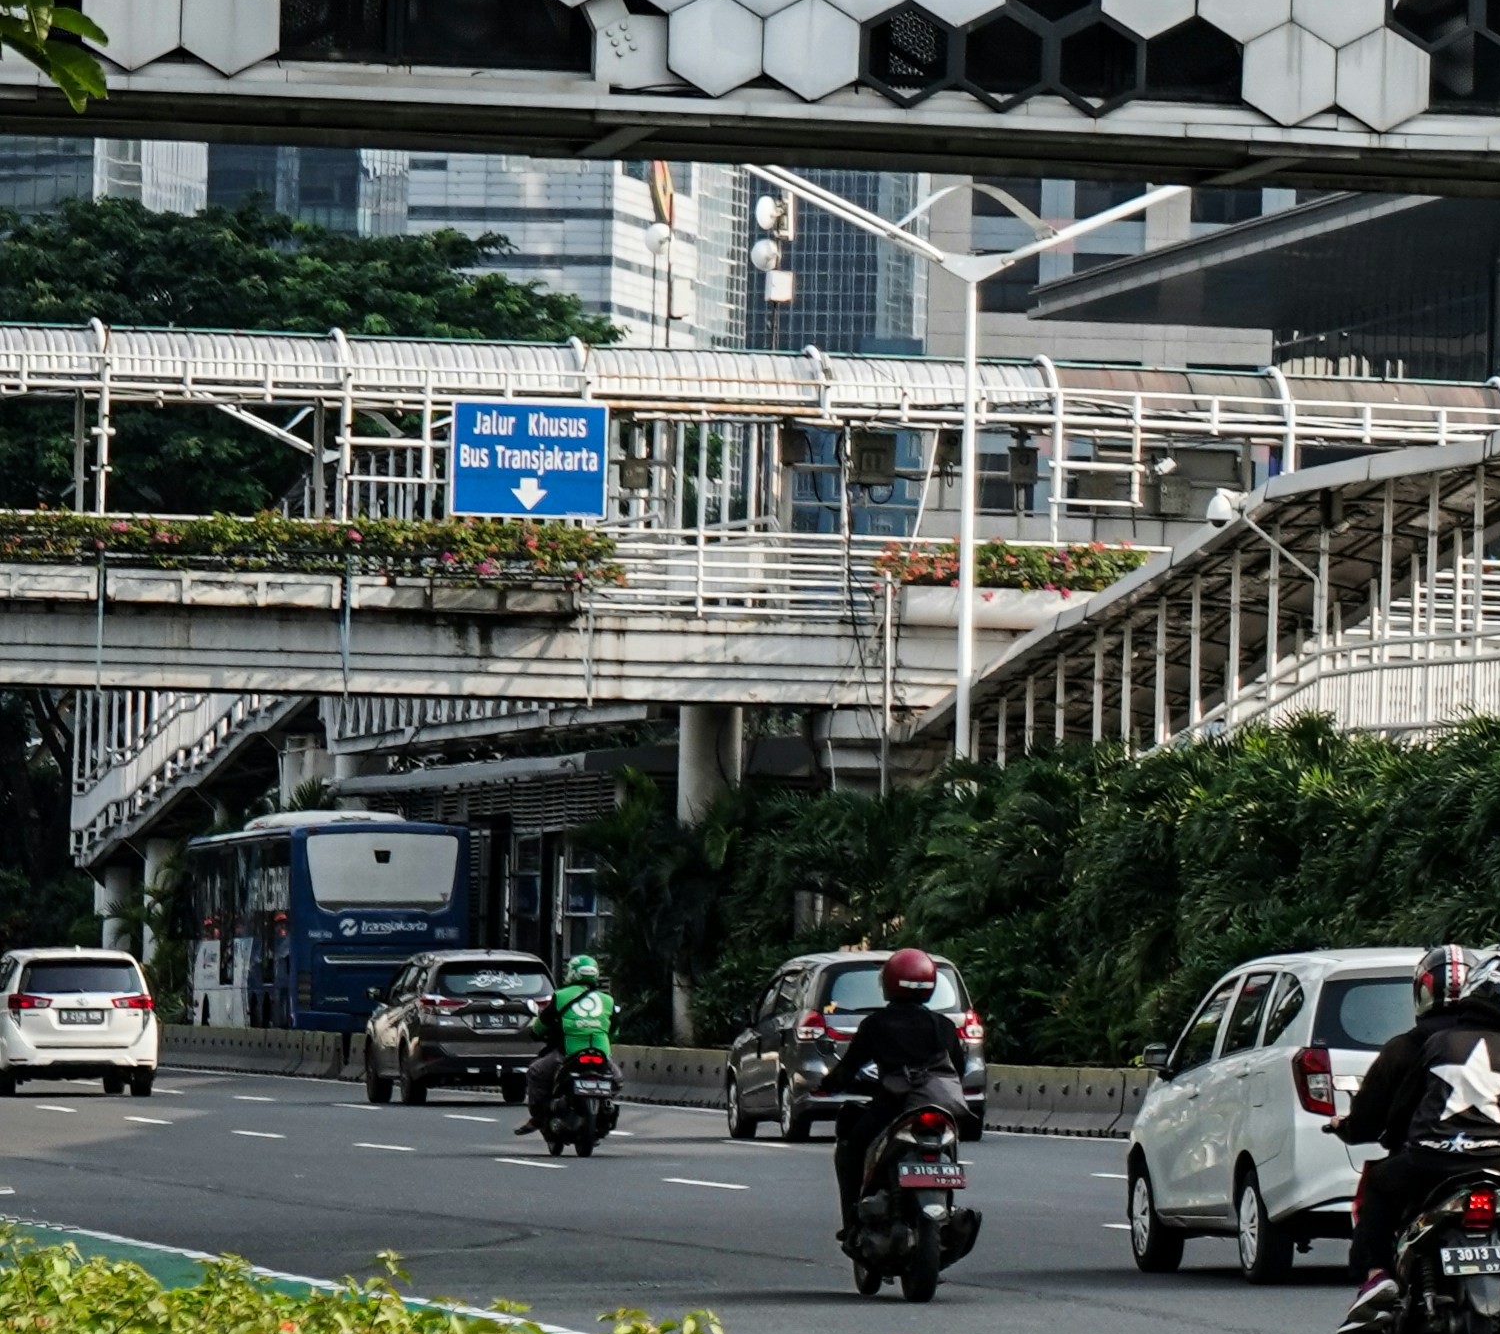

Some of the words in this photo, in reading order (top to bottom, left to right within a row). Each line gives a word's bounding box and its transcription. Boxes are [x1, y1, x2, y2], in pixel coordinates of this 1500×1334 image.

[473, 410, 517, 436] Jalur
[528, 412, 587, 438] Khusus
[460, 443, 489, 468] Bus
[495, 444, 599, 475] Transjakarta
[1442, 1249, 1451, 1262] B
[1457, 1248, 1489, 1261] 3013
